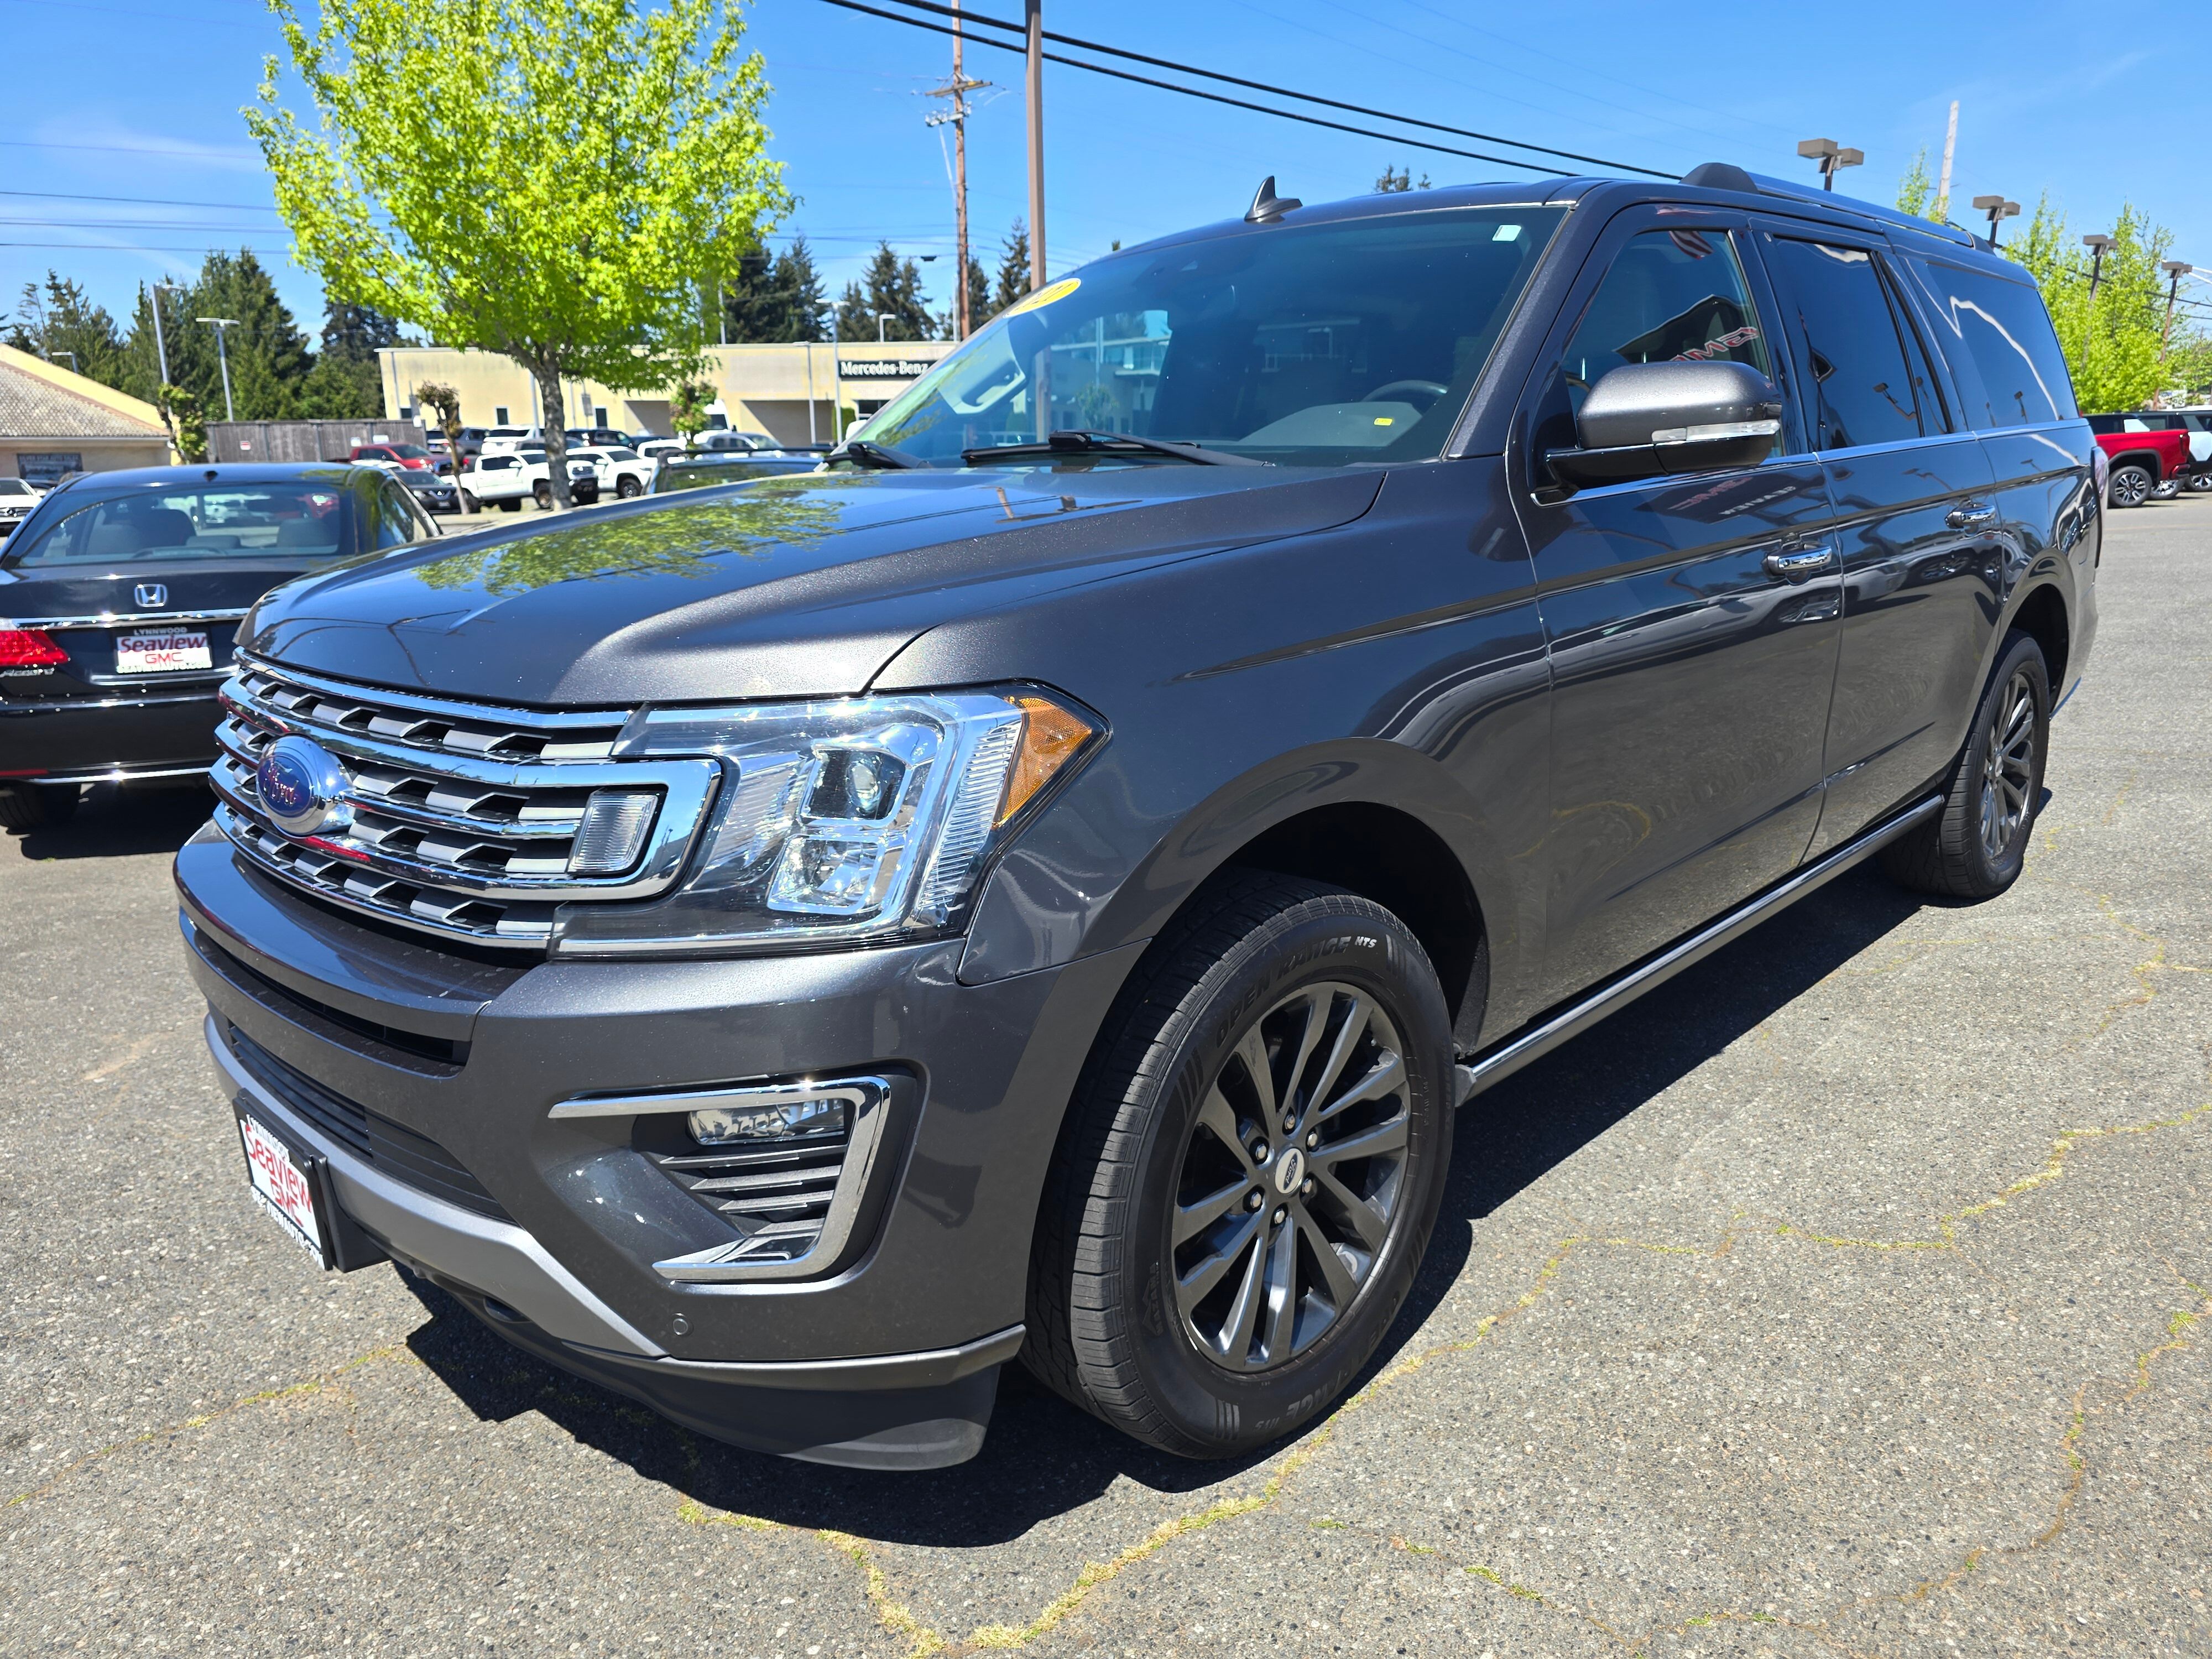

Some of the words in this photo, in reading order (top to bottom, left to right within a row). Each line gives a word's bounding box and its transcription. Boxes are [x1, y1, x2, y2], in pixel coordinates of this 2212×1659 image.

[841, 361, 929, 376] Mercedes-Benz
[133, 627, 187, 636] LYNNWOOD
[121, 635, 206, 653] Seaview
[145, 652, 184, 664] GMC
[245, 1123, 312, 1213] Seaview
[1285, 1159, 1296, 1184] Ford
[269, 1176, 304, 1227] GMC
